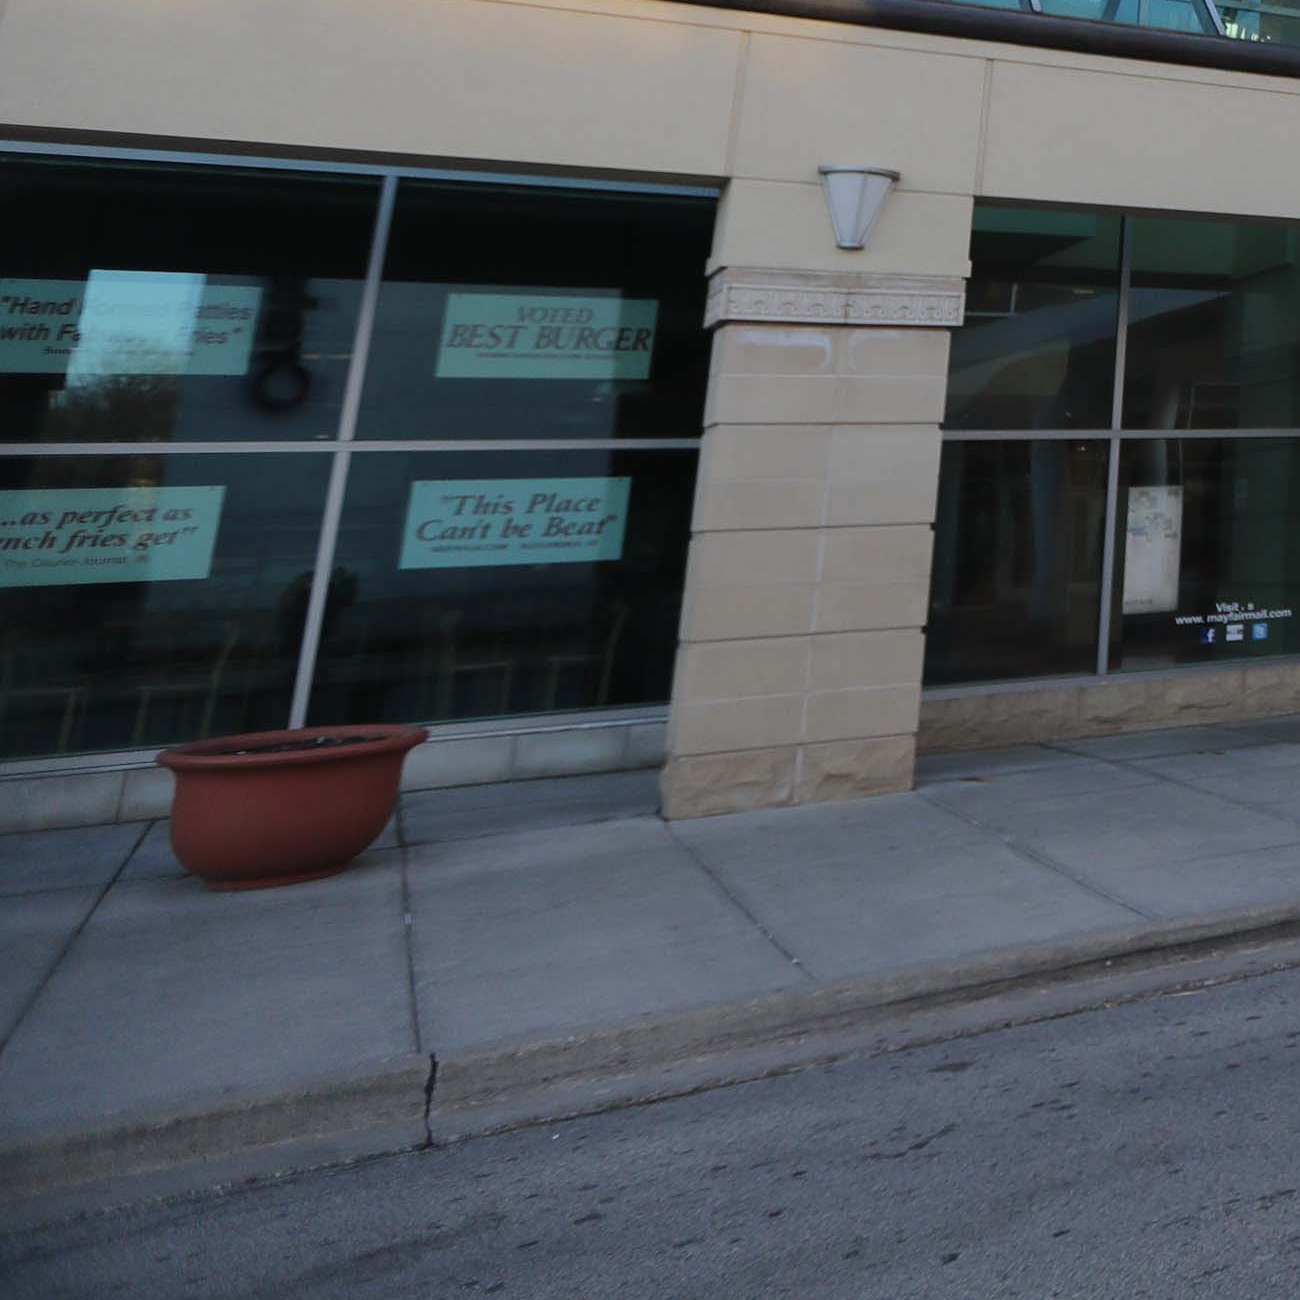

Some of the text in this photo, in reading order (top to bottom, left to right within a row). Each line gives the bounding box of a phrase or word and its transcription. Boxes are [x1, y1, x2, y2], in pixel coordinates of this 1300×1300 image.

[515, 306, 594, 324] VOTED
[0, 323, 50, 341] with
[447, 324, 652, 352] BEST BURGER
[525, 492, 601, 514] Place
[56, 504, 159, 529] perfect
[162, 507, 193, 521] as
[501, 517, 531, 539] be
[59, 528, 130, 553] fries
[1215, 601, 1240, 613] Visit
